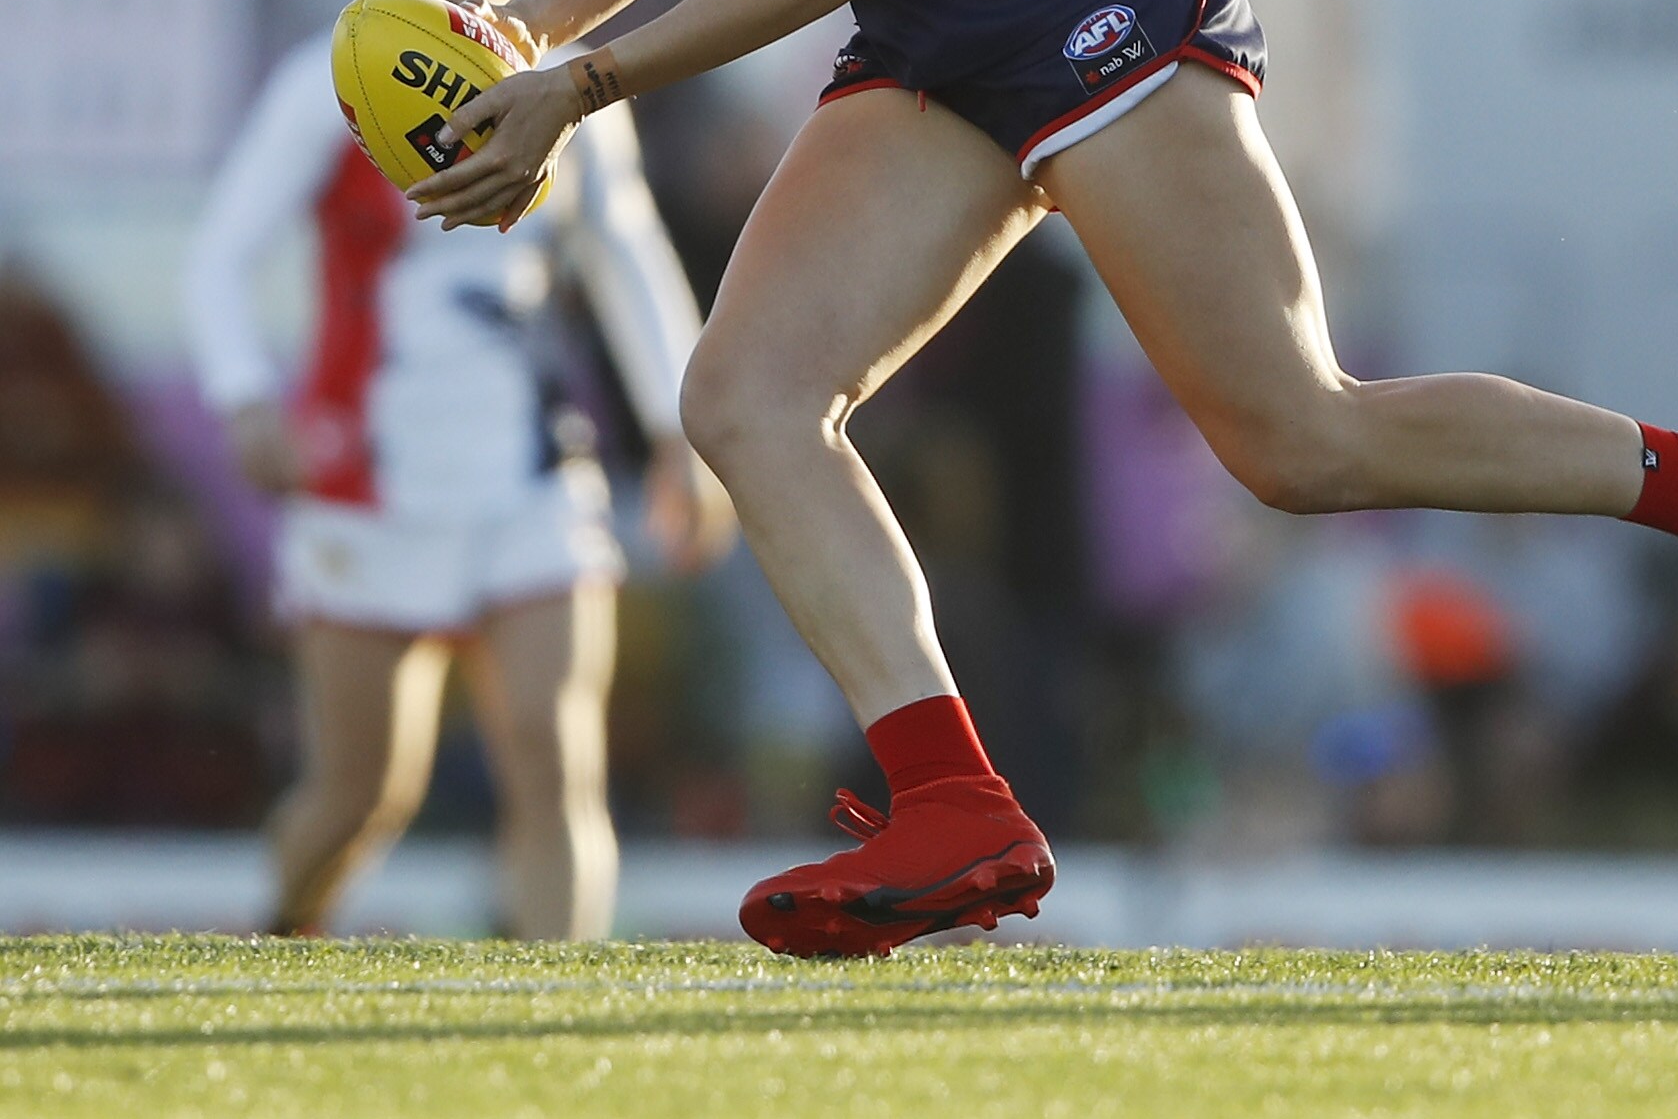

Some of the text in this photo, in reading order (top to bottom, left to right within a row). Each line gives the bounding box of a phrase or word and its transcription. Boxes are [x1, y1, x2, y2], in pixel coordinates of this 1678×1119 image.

[1073, 11, 1131, 56] AFL
[1100, 57, 1123, 77] nab
[426, 145, 445, 163] nab
